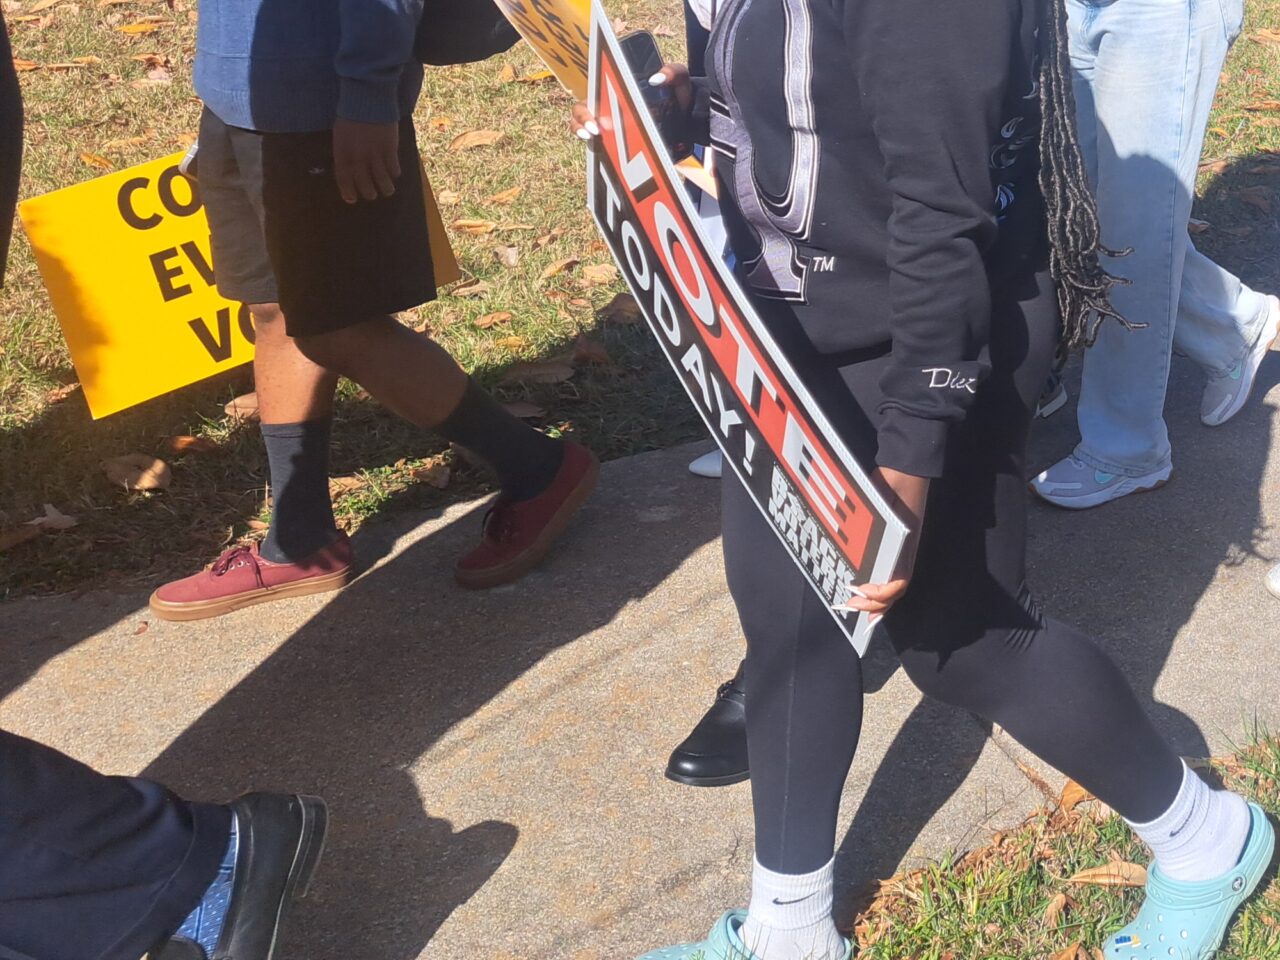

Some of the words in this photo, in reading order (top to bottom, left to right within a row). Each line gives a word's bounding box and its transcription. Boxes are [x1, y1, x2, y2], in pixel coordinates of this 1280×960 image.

[600, 160, 755, 476] TODAY!
[604, 71, 848, 534] VOTE
[812, 257, 836, 272] TM
[768, 497, 849, 620] MATTER
[772, 484, 852, 602] VOTERS
